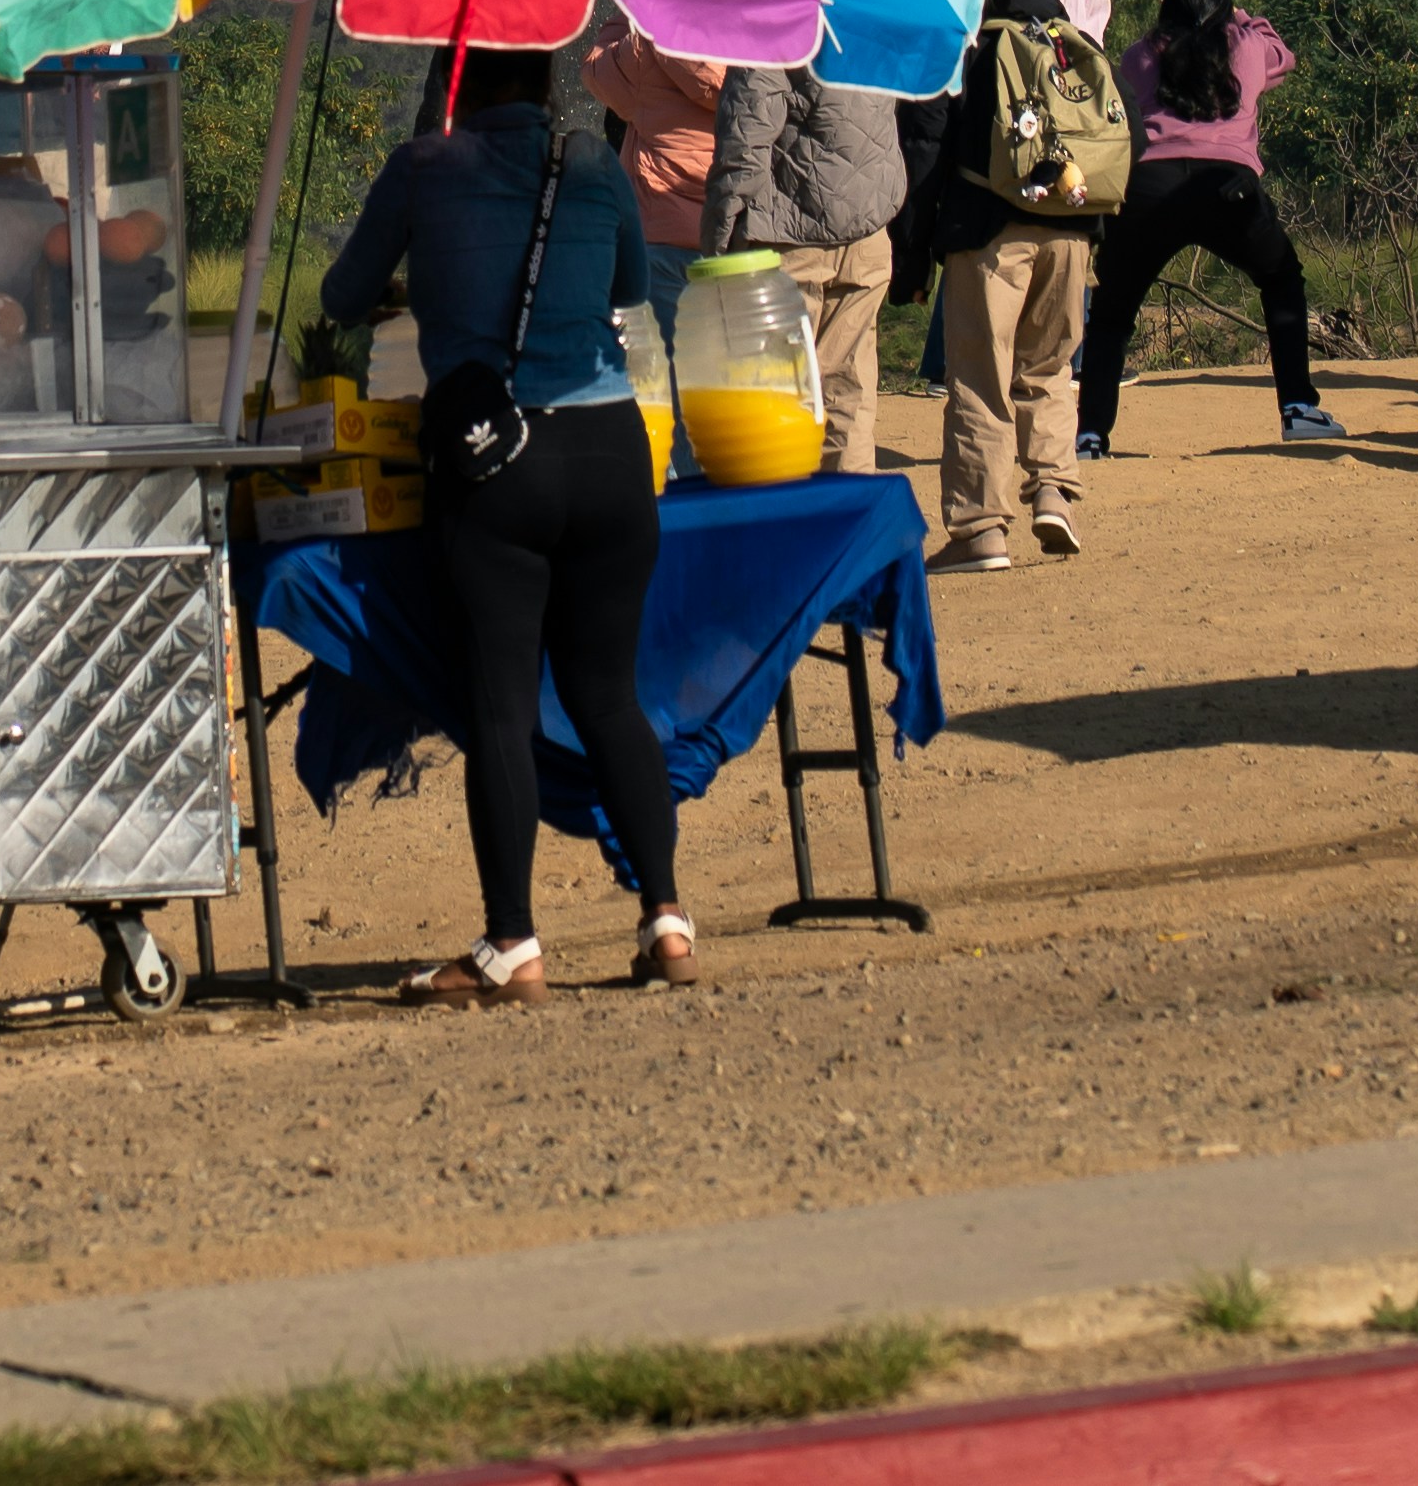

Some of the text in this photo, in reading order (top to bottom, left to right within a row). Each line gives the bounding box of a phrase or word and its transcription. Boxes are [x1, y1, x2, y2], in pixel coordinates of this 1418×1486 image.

[117, 109, 141, 163] A
[542, 177, 557, 219] adidas
[529, 242, 544, 284] adidas
[516, 308, 530, 351] adidas
